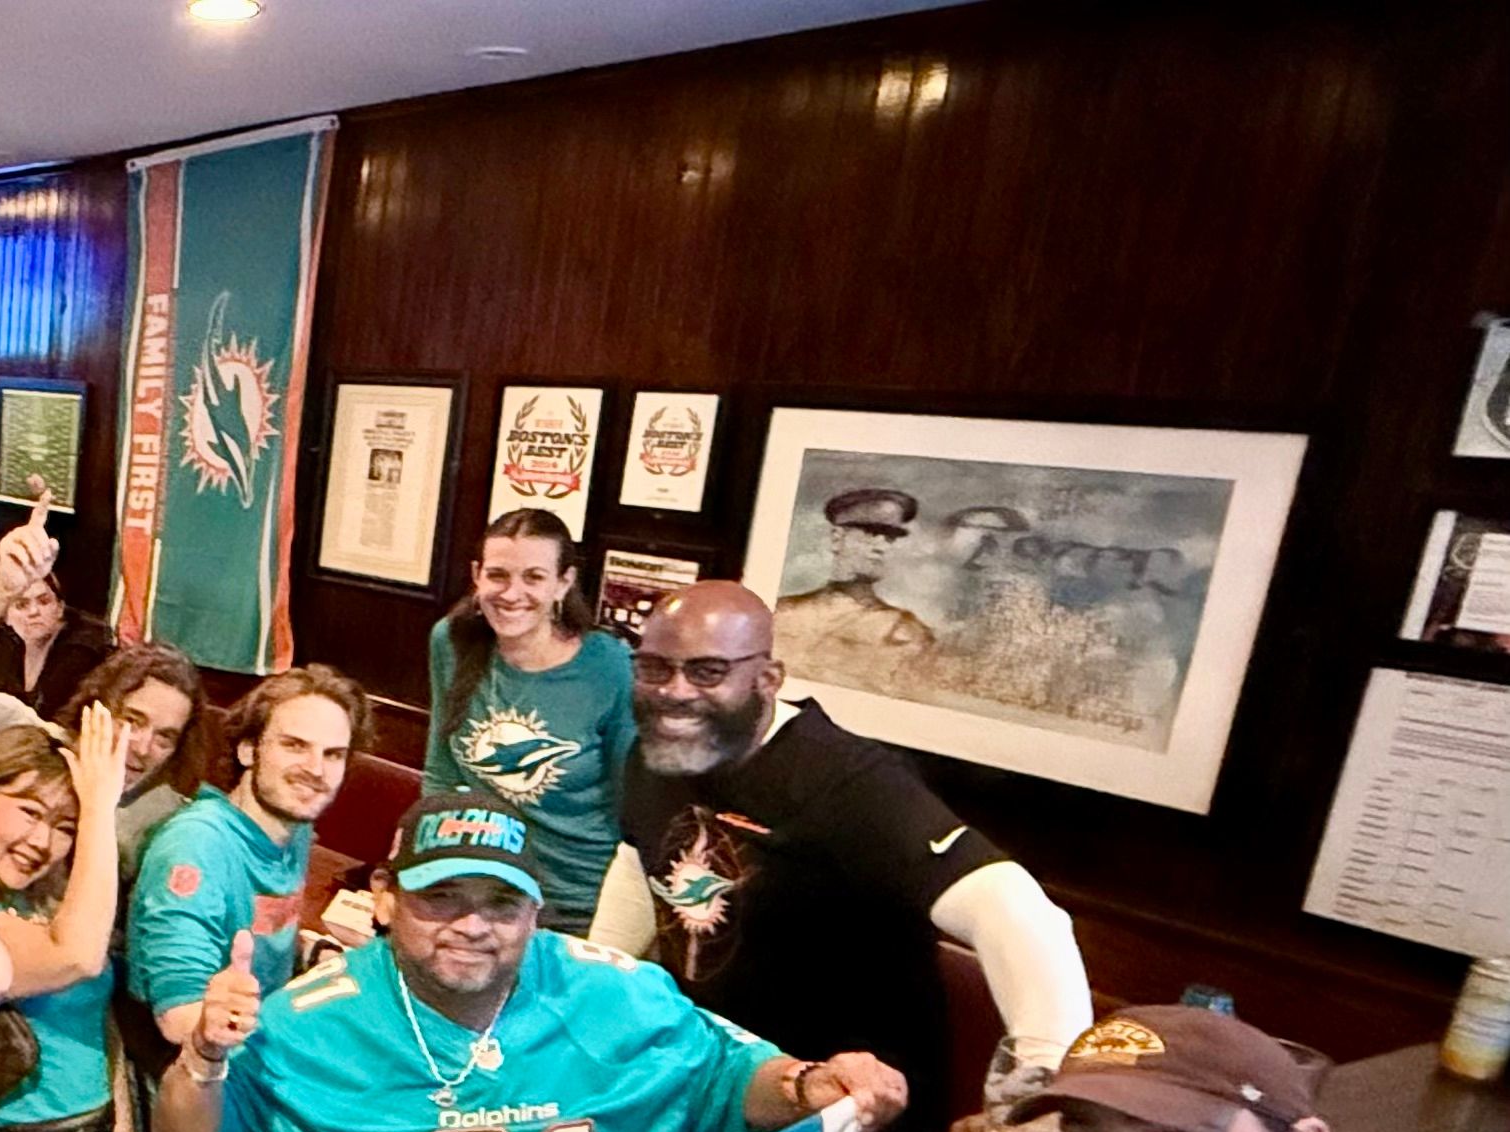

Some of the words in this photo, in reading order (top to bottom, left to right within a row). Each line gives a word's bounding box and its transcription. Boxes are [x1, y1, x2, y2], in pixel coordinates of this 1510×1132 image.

[134, 293, 170, 419] FAMILY
[506, 430, 590, 447] BOSTON'S
[522, 445, 569, 459] BEST
[124, 434, 162, 535] FIRST
[438, 1101, 561, 1128] Dolphins
